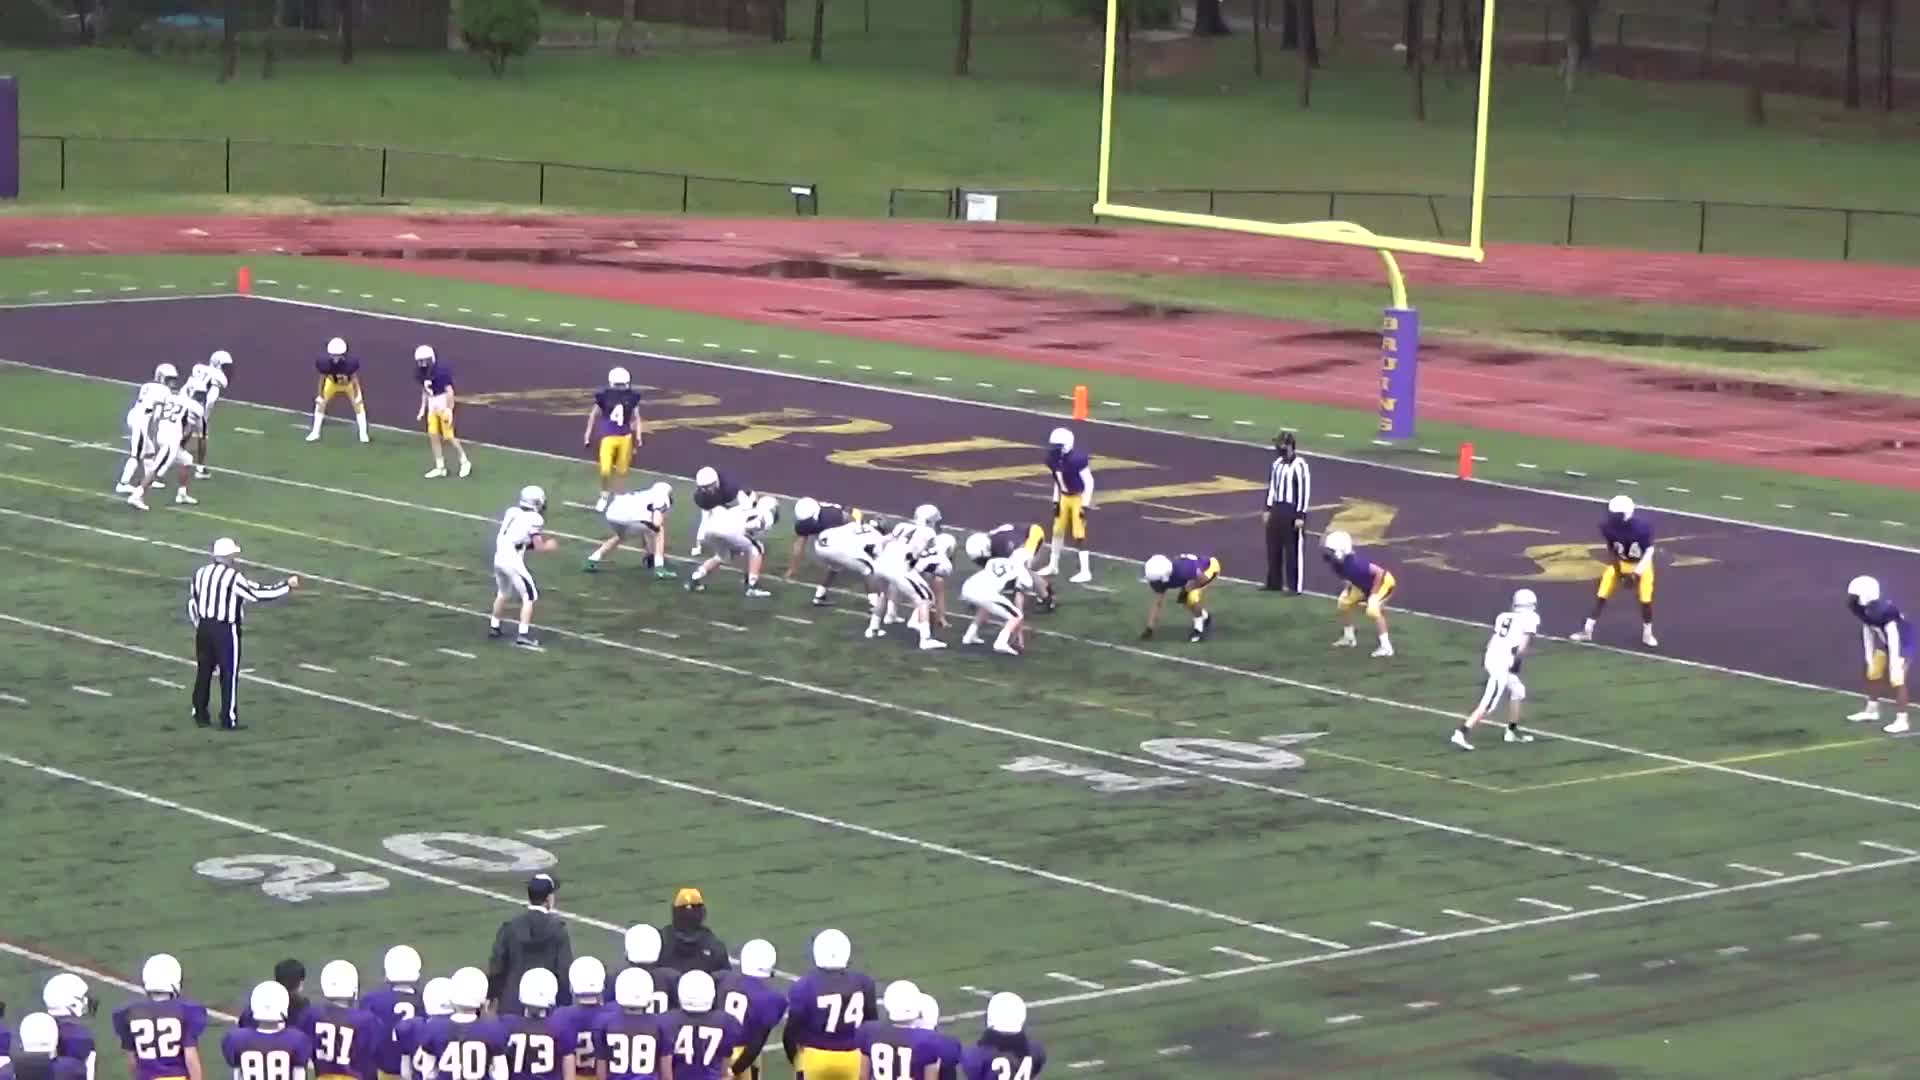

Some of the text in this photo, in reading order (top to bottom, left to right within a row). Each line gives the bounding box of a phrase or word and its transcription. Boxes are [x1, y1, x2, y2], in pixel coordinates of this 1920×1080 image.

[610, 404, 624, 426] 4
[193, 831, 559, 902] 20
[817, 991, 864, 1032] 74
[130, 1017, 182, 1059] 22
[315, 1022, 354, 1065] 31
[508, 1033, 554, 1074] 73
[606, 1033, 656, 1074] 38
[674, 1025, 723, 1066] 47
[438, 1041, 487, 1080] 40
[871, 1043, 912, 1080] 81
